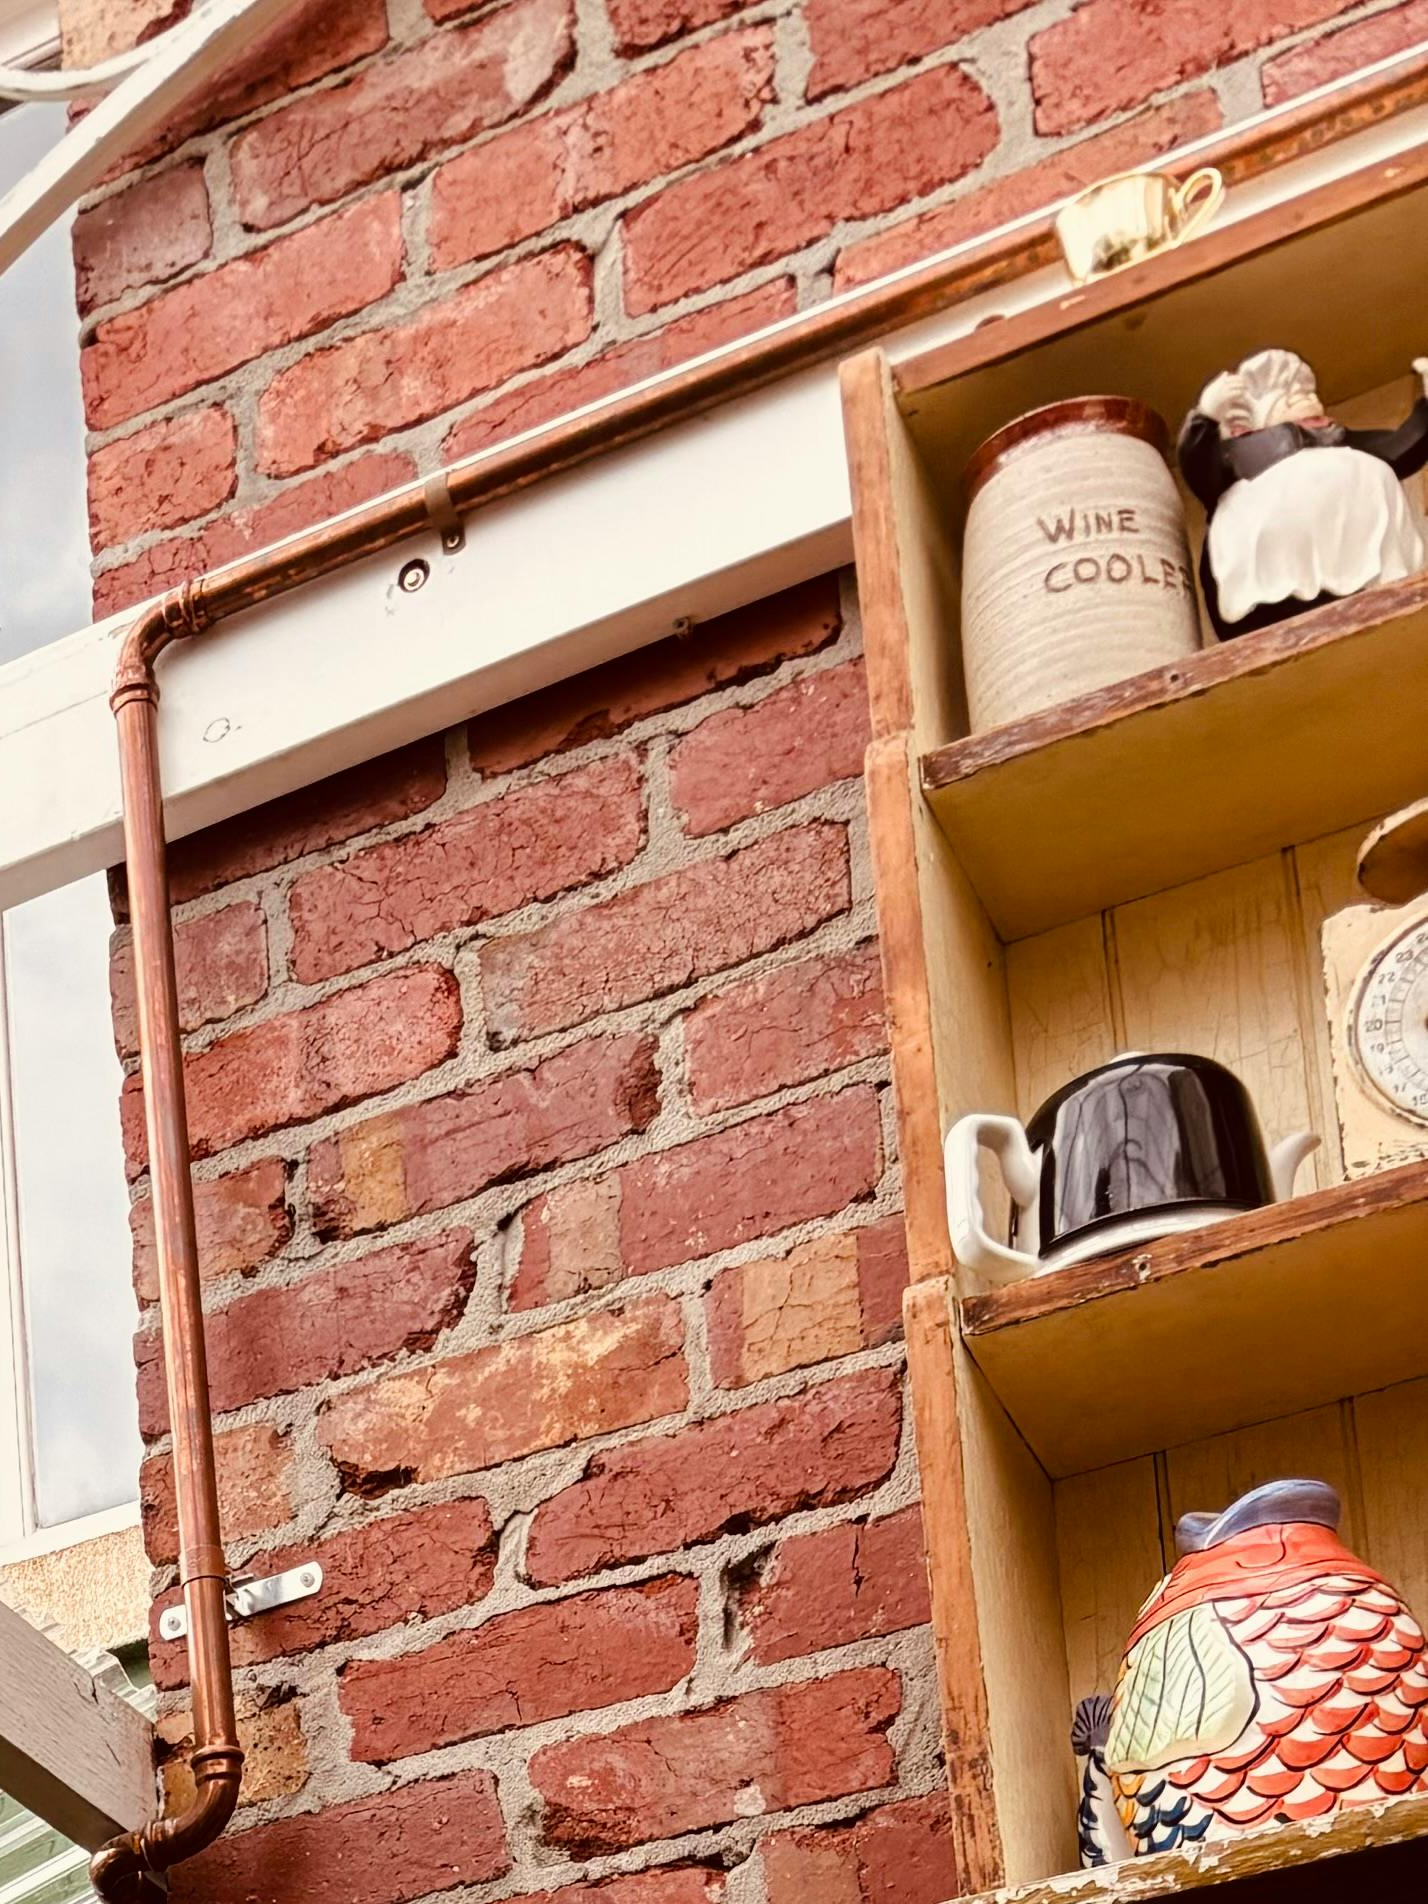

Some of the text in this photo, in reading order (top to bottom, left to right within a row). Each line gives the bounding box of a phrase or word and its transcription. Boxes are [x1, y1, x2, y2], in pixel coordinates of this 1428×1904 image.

[1037, 507, 1139, 543] WINE
[1396, 949, 1414, 963] 23
[1364, 1019, 1384, 1033] 20
